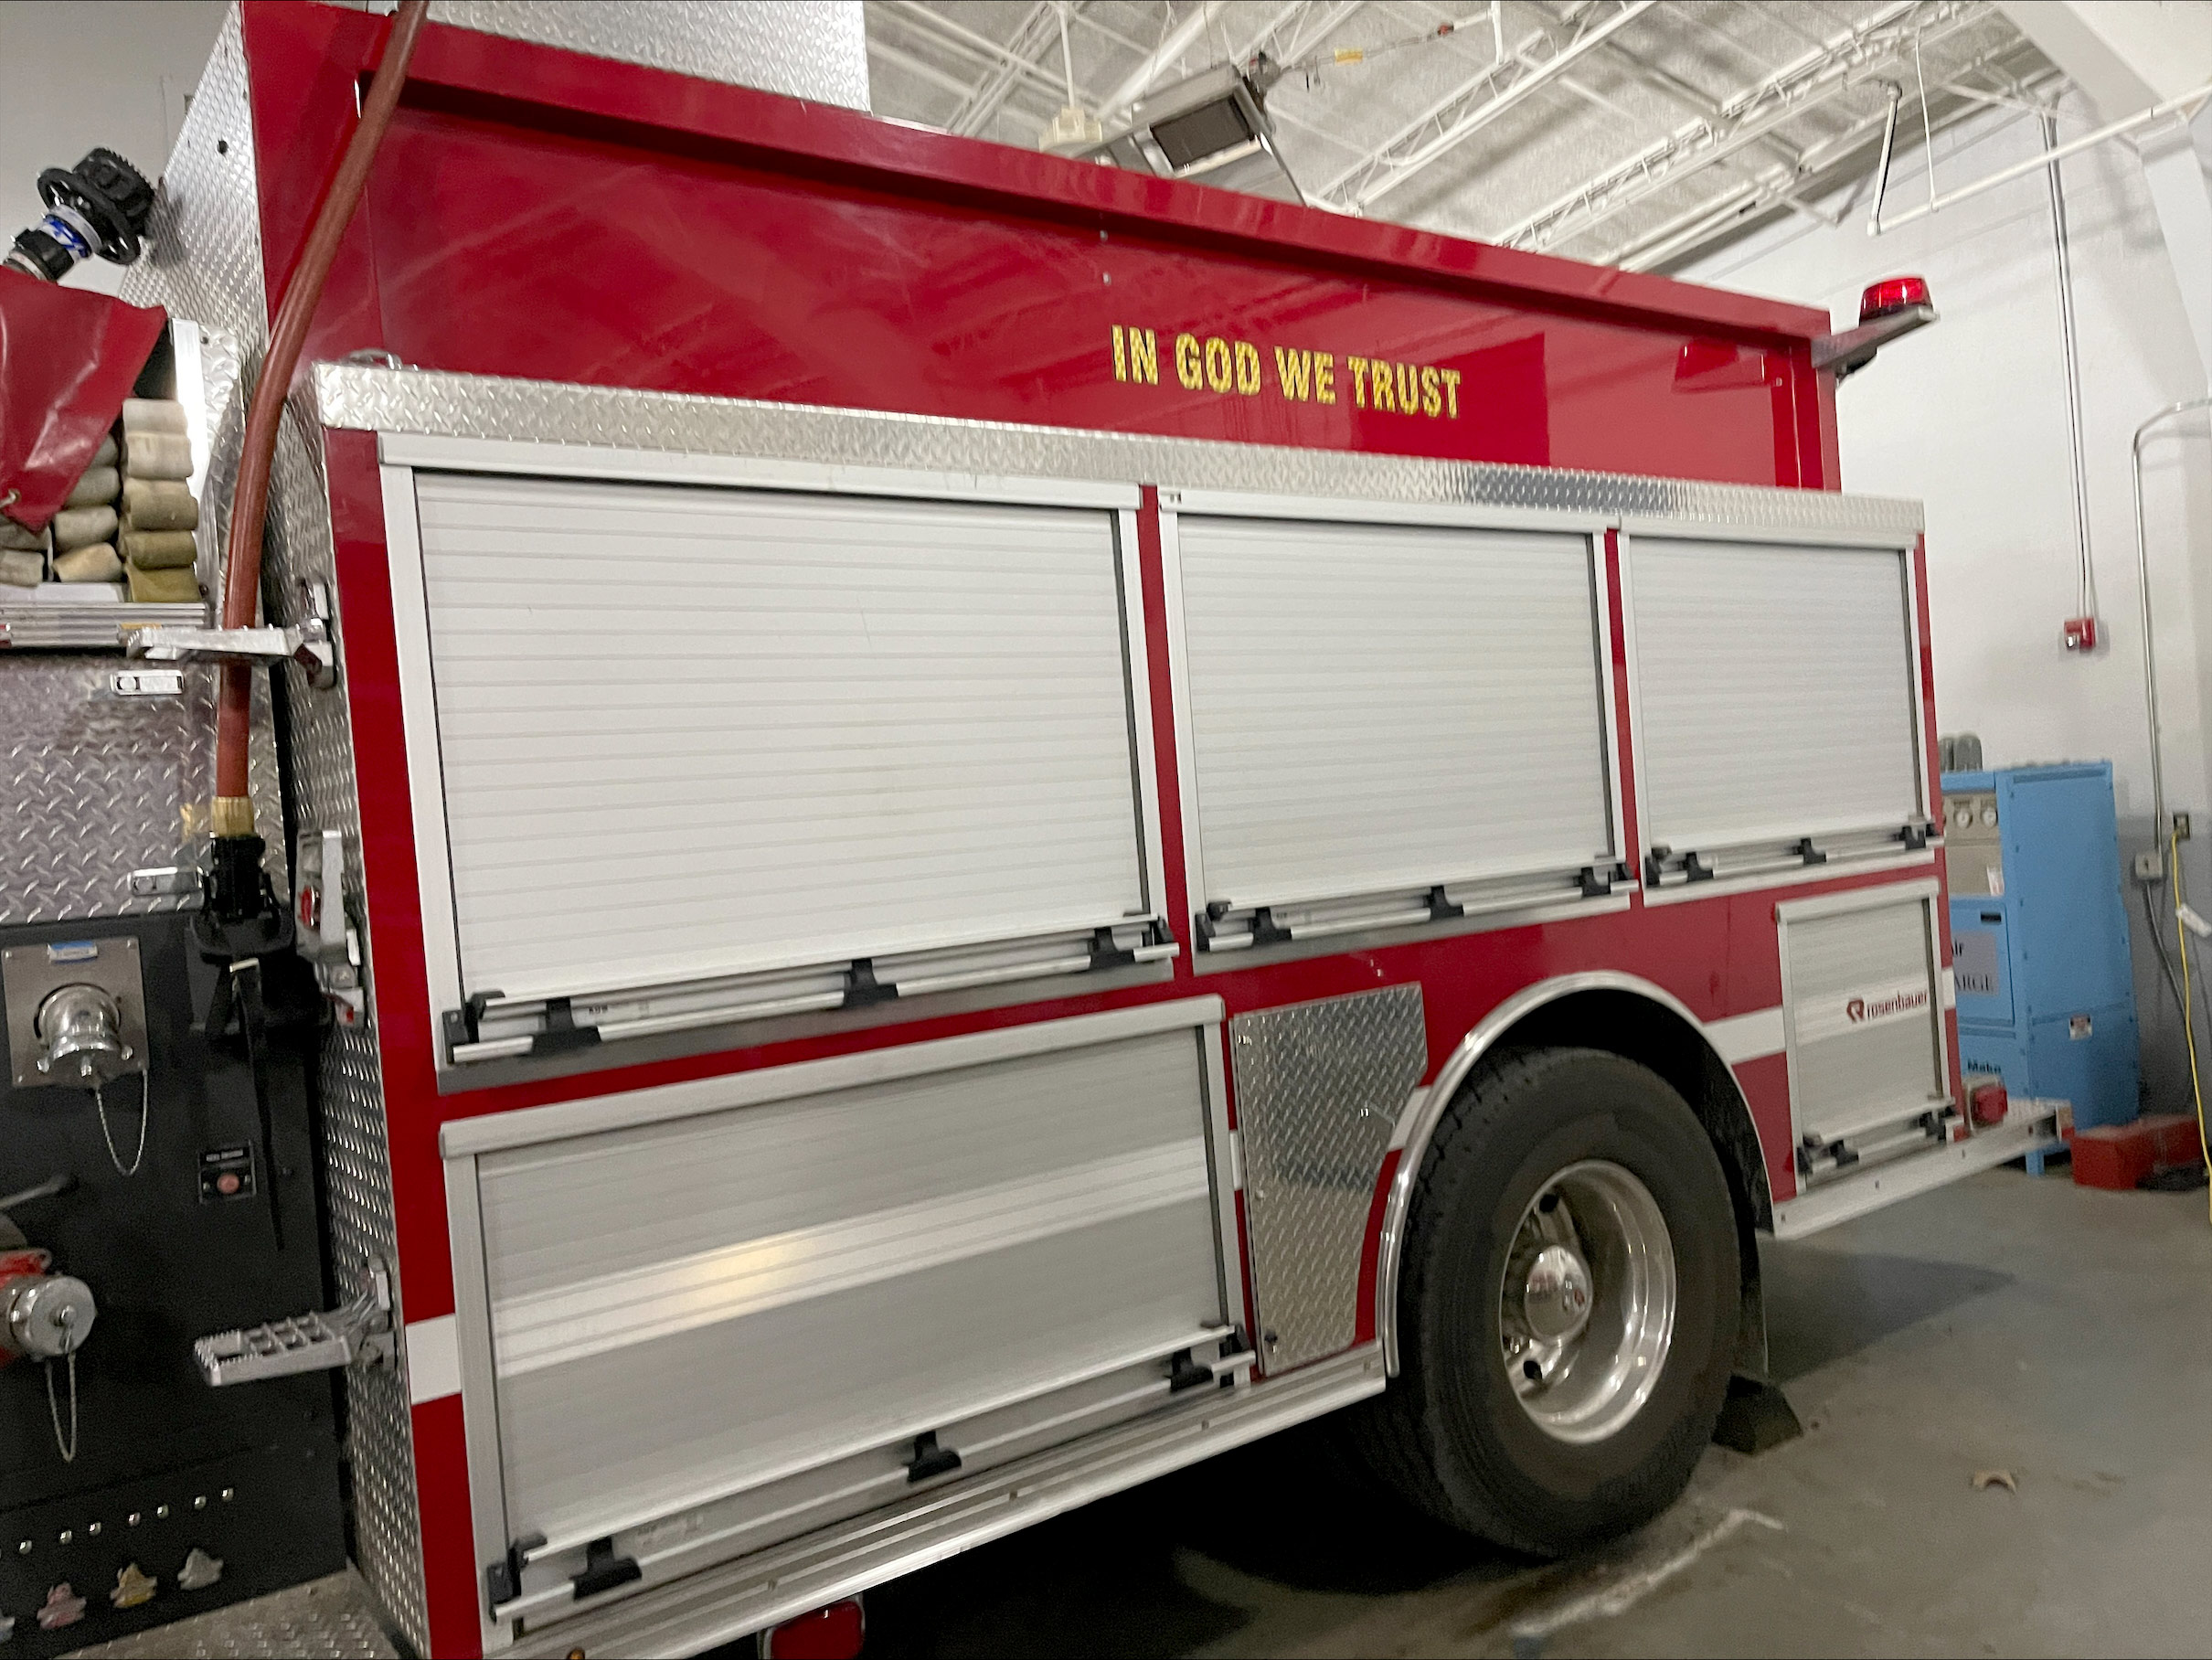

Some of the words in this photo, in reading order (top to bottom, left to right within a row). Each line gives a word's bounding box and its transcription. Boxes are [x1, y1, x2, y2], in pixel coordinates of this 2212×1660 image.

[1111, 324, 1159, 386] IN
[1175, 332, 1260, 396] GOD
[1273, 345, 1337, 405] WE
[1346, 354, 1462, 420] TRUST
